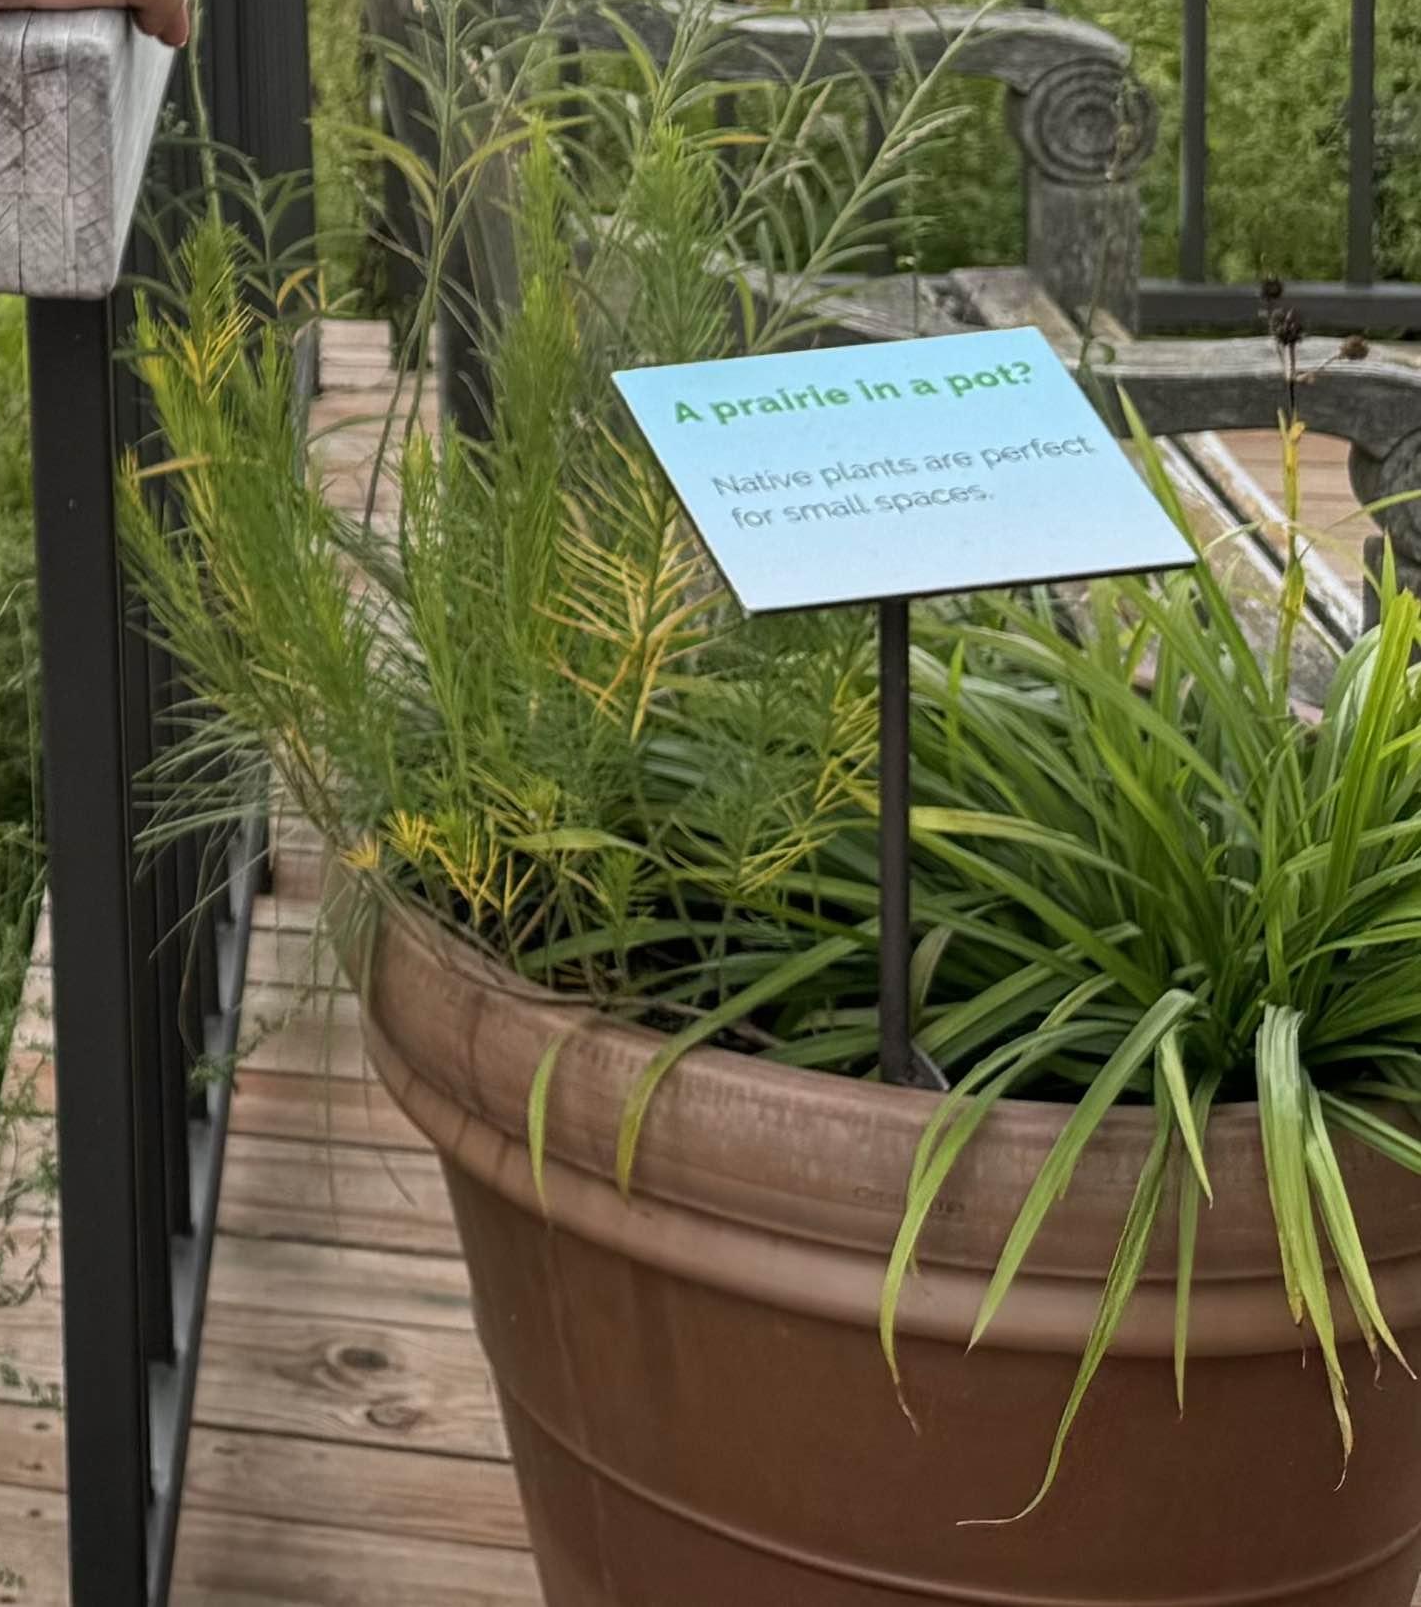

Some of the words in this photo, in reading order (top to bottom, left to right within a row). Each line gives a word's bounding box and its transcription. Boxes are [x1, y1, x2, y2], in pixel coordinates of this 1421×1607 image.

[674, 400, 703, 424] A
[709, 384, 850, 425] prairie
[854, 379, 901, 401] in
[908, 379, 939, 395] a
[943, 361, 1031, 398] pot?
[711, 469, 813, 496] Native
[819, 457, 918, 489] plants
[924, 451, 973, 472] are
[980, 435, 1097, 471] perfect
[731, 506, 772, 530] for
[782, 493, 871, 523] small
[873, 484, 994, 515] spaces.
